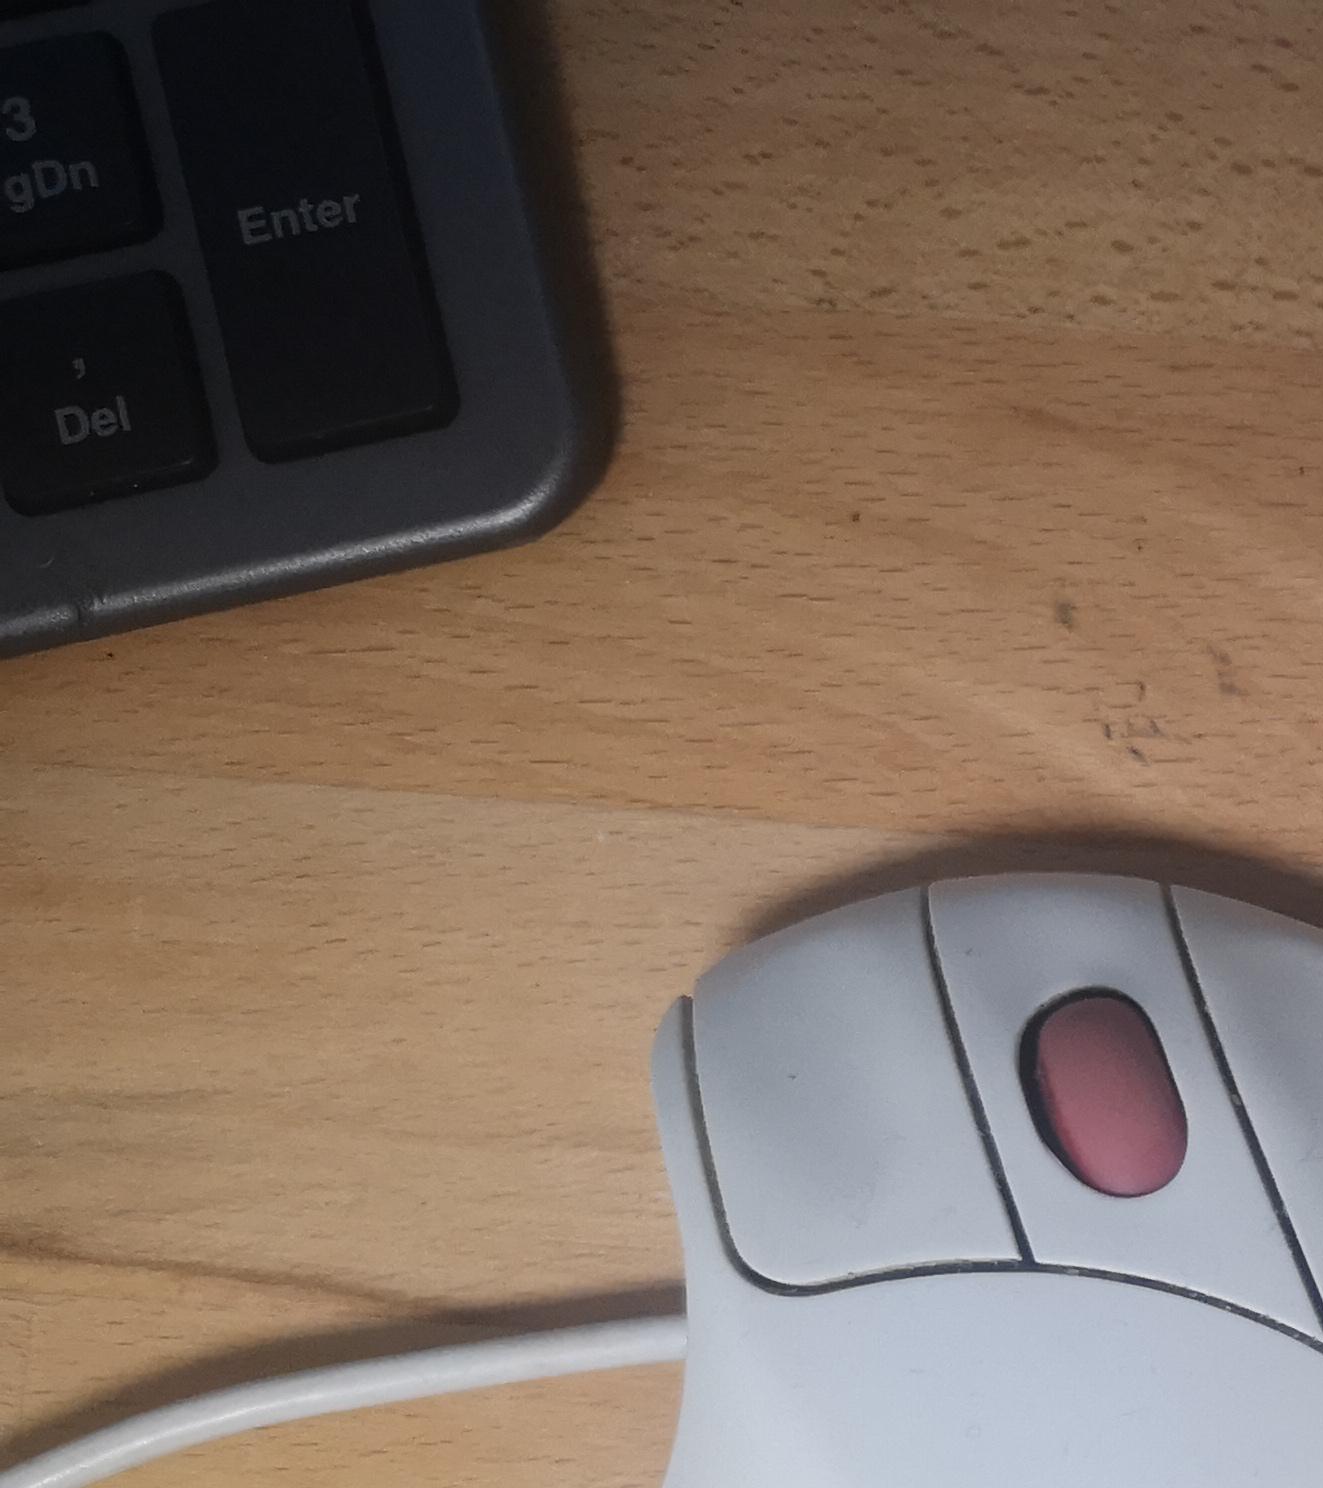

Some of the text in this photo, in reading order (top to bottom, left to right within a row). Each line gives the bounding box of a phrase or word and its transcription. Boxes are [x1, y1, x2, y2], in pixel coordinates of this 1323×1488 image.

[2, 96, 37, 142] 3
[3, 159, 99, 213] gDn
[237, 193, 361, 246] Enter
[54, 395, 132, 446] Del
